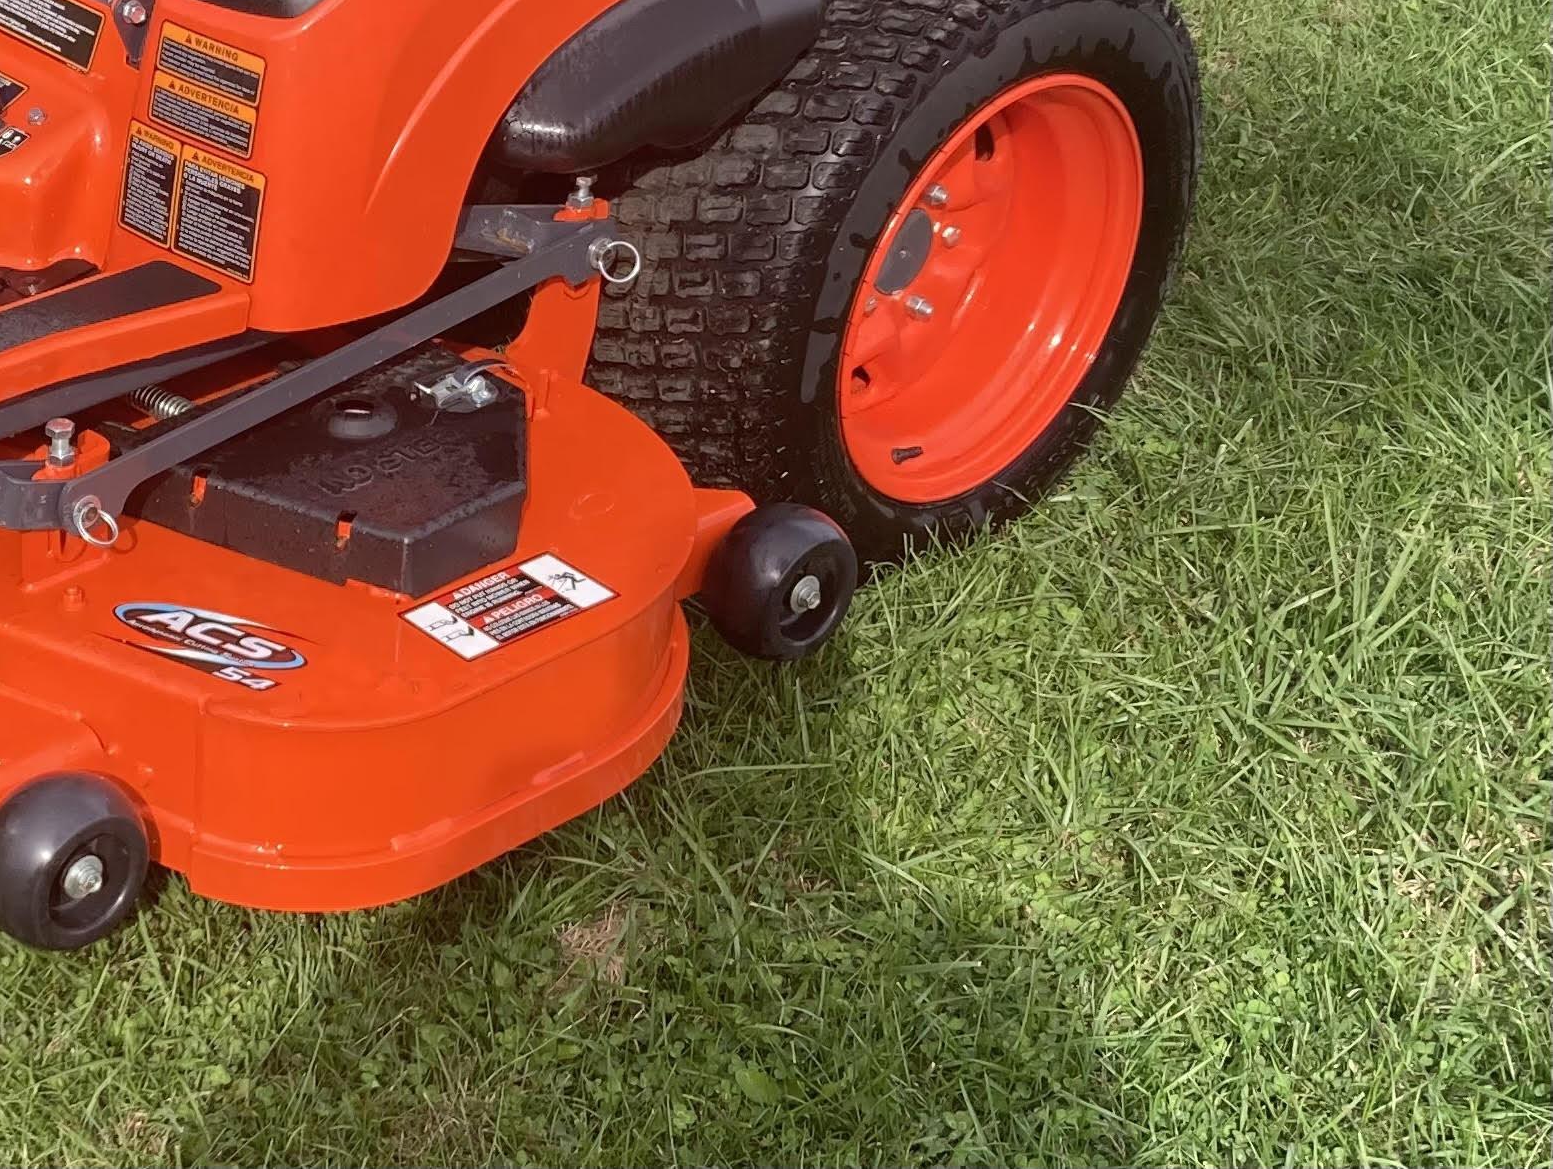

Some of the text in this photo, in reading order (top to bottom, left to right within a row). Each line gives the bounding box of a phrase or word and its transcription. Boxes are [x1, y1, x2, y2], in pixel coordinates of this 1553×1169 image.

[194, 38, 239, 62] WARNING
[178, 83, 239, 115] ADVERTENCIA
[143, 129, 175, 151] WARNING
[202, 154, 255, 183] ADVERTENCIA
[460, 572, 511, 596] DANGER
[492, 593, 544, 621] PELIGRO
[137, 609, 287, 660] ACS
[212, 666, 276, 691] 54
